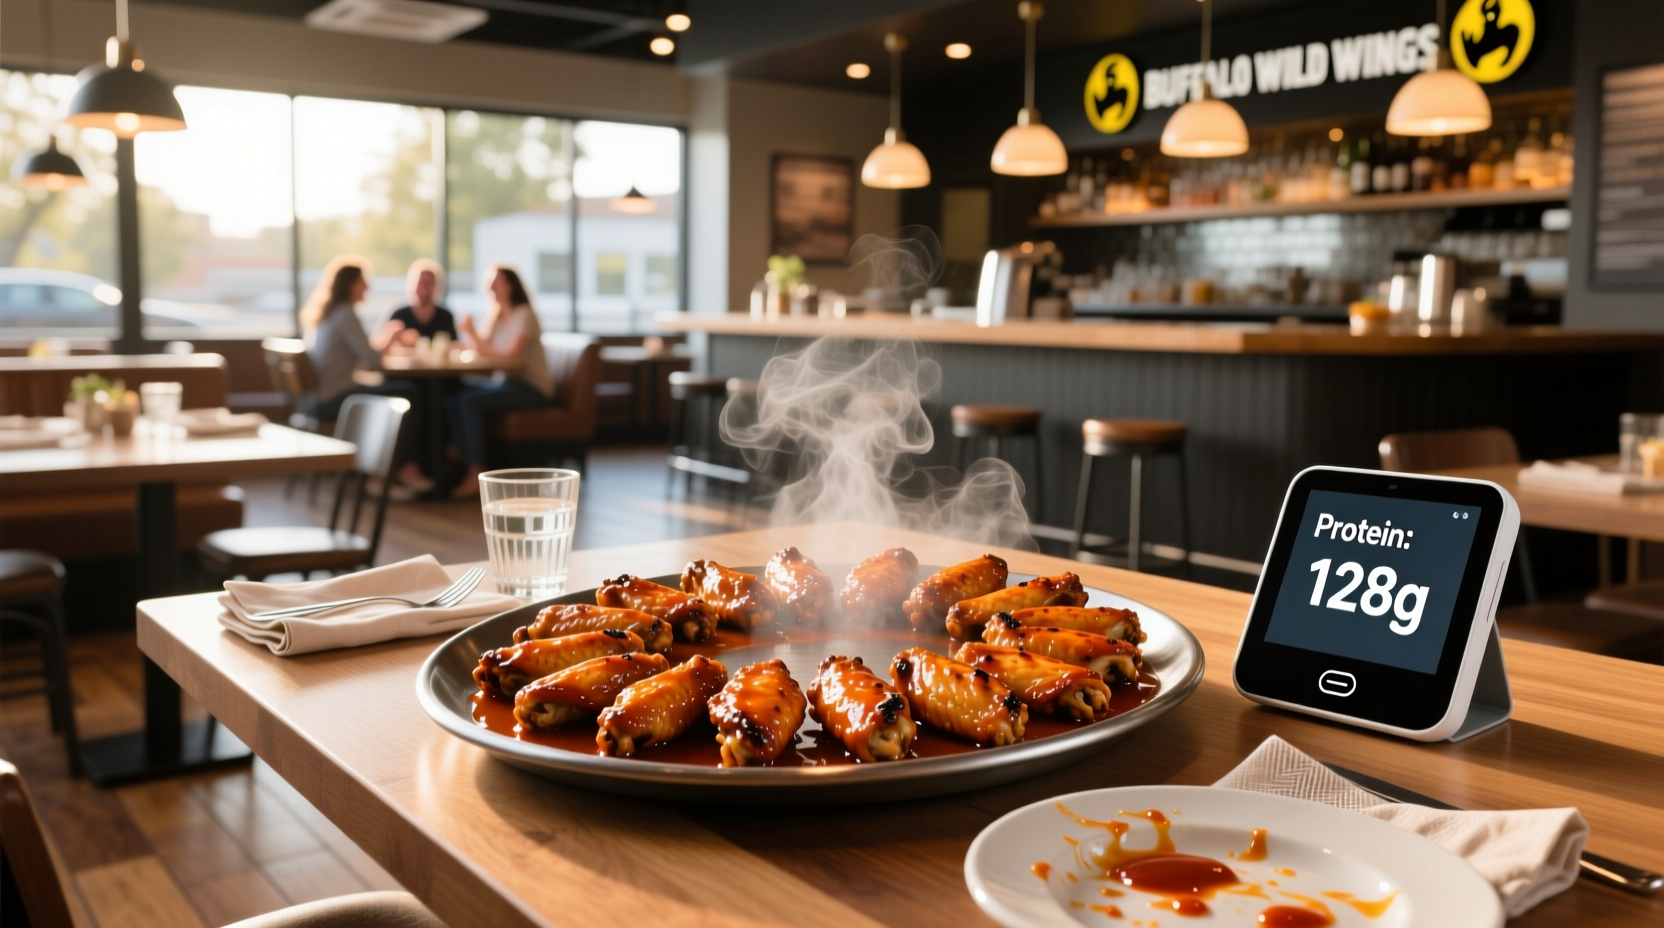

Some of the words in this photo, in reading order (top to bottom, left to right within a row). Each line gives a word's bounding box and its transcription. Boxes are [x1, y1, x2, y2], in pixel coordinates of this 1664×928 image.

[1253, 41, 1329, 94] WILD
[1330, 23, 1440, 83] WINGS
[1313, 512, 1414, 550] Protein:
[1309, 558, 1430, 636] 128g
